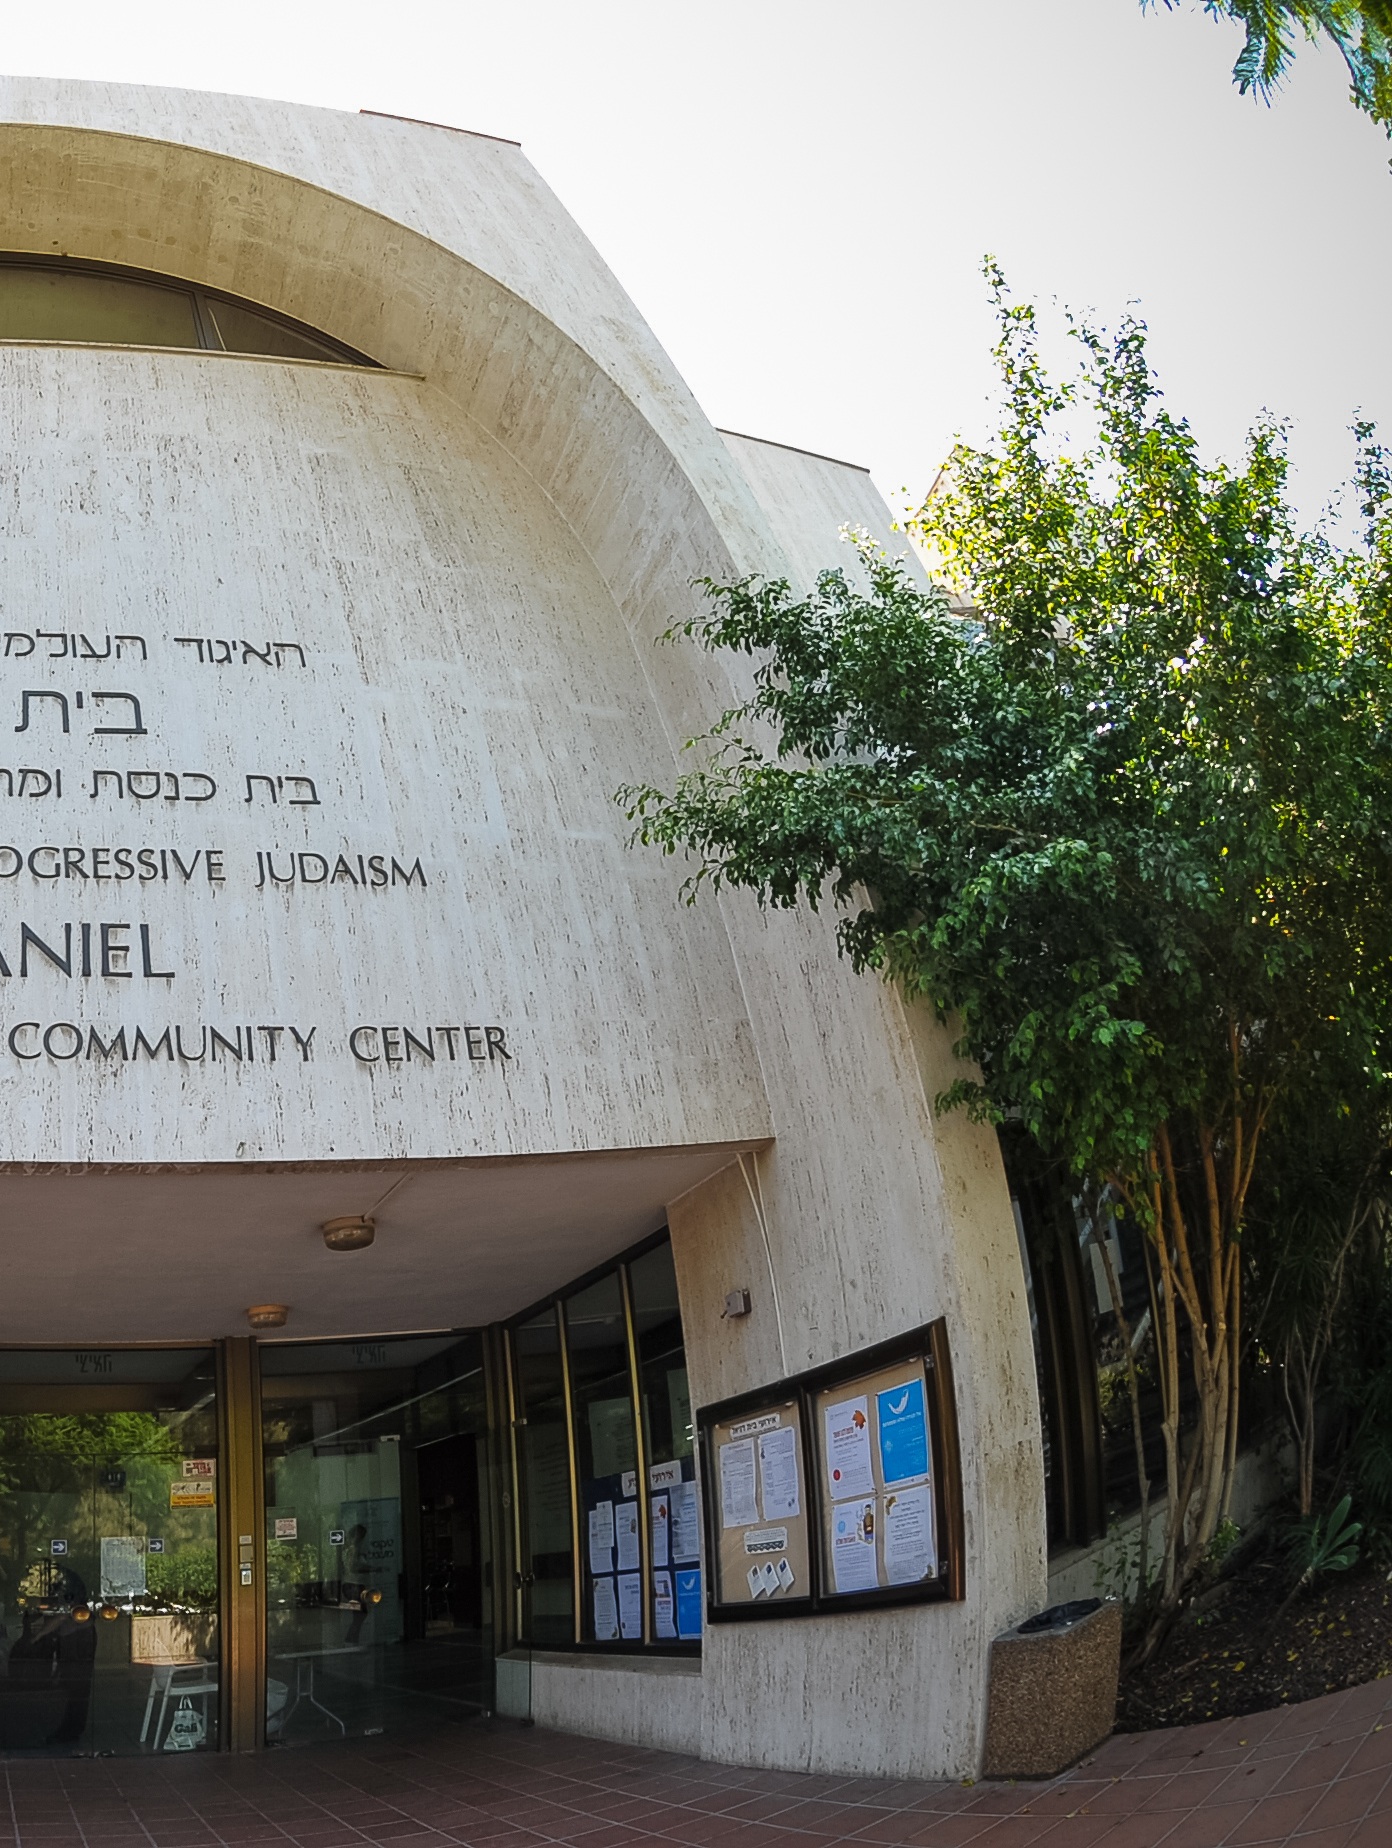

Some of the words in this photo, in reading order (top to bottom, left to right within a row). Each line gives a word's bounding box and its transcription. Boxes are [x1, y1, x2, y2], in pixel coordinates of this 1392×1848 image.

[174, 637, 306, 667] האיגוד
[14, 690, 148, 735] בית
[89, 770, 217, 801] כנסת
[244, 774, 321, 805] בית
[254, 851, 428, 888] JUDAISM
[8, 1022, 317, 1062] COMMUNITY
[349, 1026, 513, 1063] CENTER
